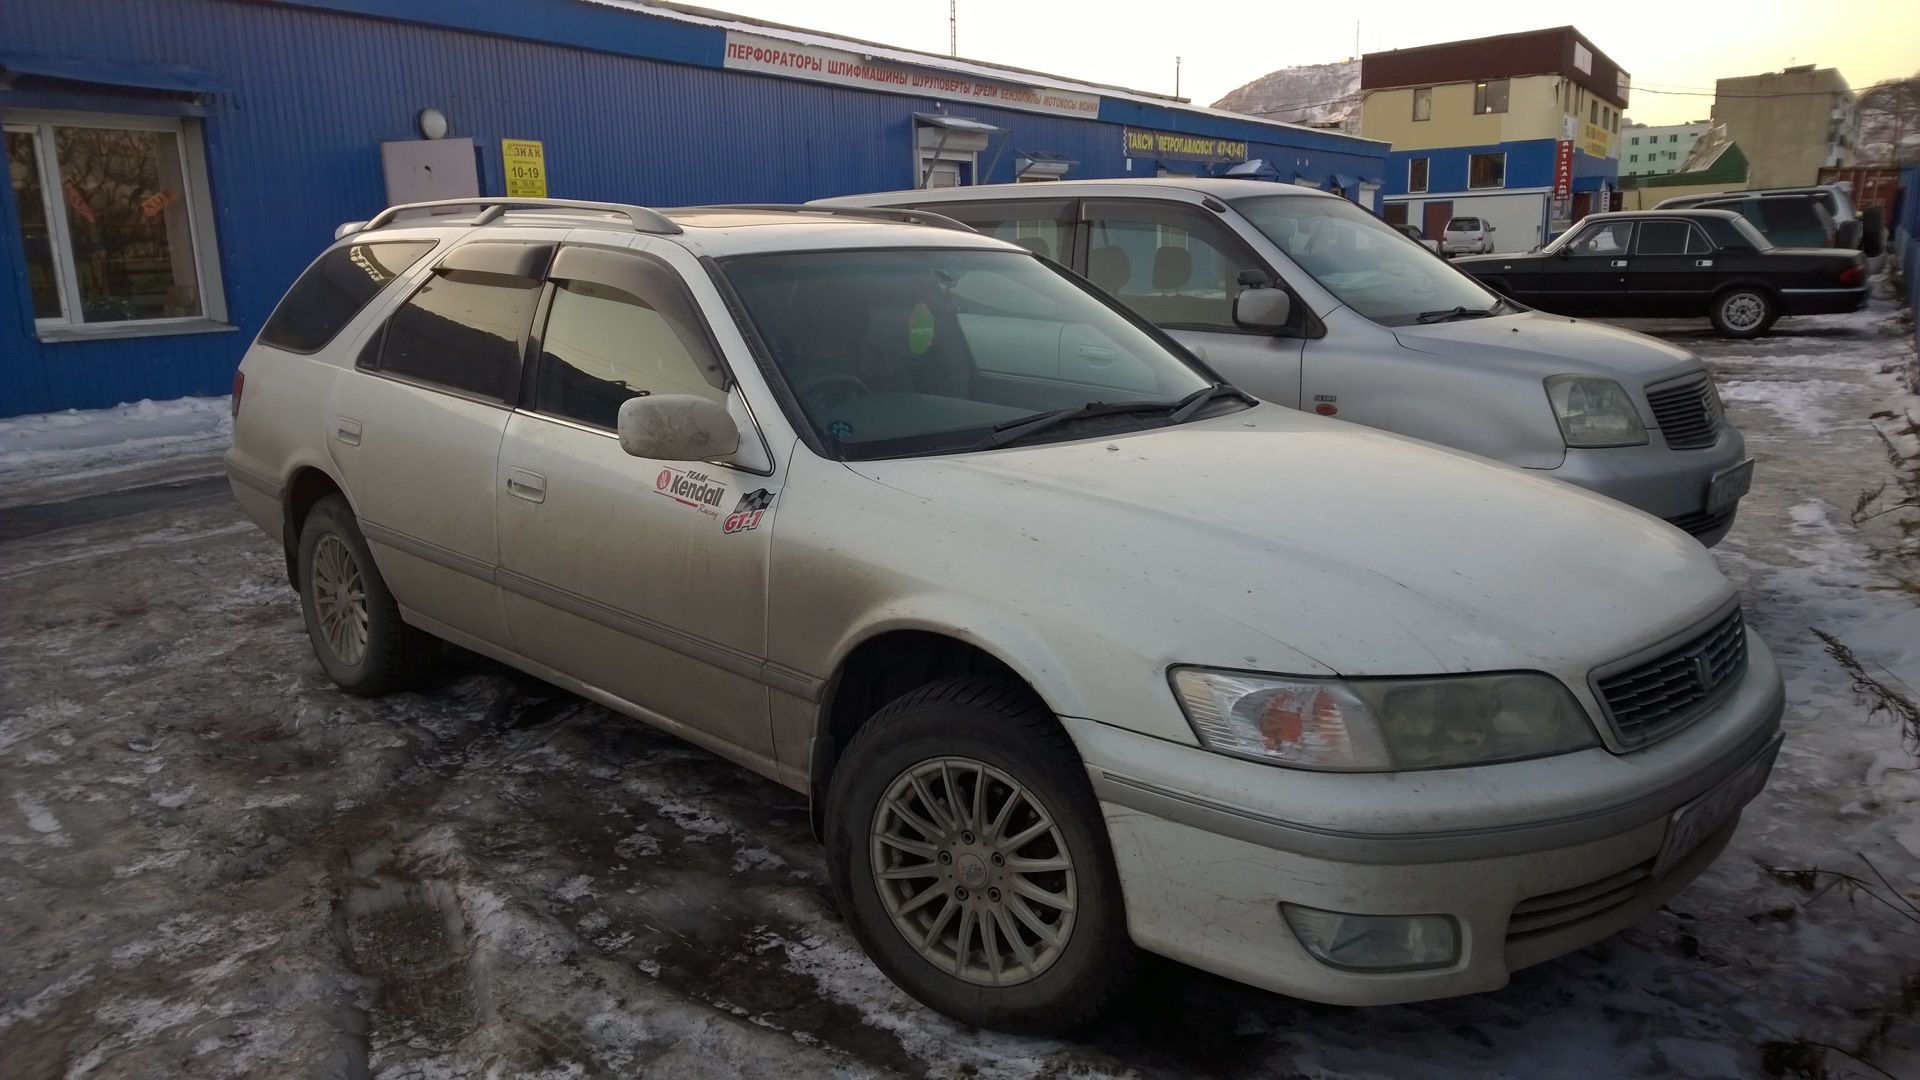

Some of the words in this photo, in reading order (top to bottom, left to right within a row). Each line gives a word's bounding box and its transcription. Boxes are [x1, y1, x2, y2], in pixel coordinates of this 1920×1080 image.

[727, 43, 822, 72] ПЕРФОРАТОРЫ
[827, 60, 908, 85] ШЛИФМАШИНЫ
[912, 74, 971, 94] ШУРУПОВЕРТЫ
[973, 83, 998, 98] ДРЕЛИ
[1000, 88, 1042, 105] БЕНЗОПИЛЫ
[1043, 95, 1077, 110] МОТОКОСЫ
[1078, 99, 1098, 113] МОЙКИ
[514, 147, 541, 157] ЗНАК
[1128, 132, 1153, 150] ТАКСИ
[1156, 134, 1216, 155] "ПЕТРОПАВЛОВСК"
[1217, 141, 1245, 158] 47-47-47
[511, 166, 539, 178] 10-19
[685, 470, 709, 482] TEAM
[670, 474, 725, 508] Kendall
[697, 503, 719, 520] Racing
[723, 509, 764, 534] GT-1
